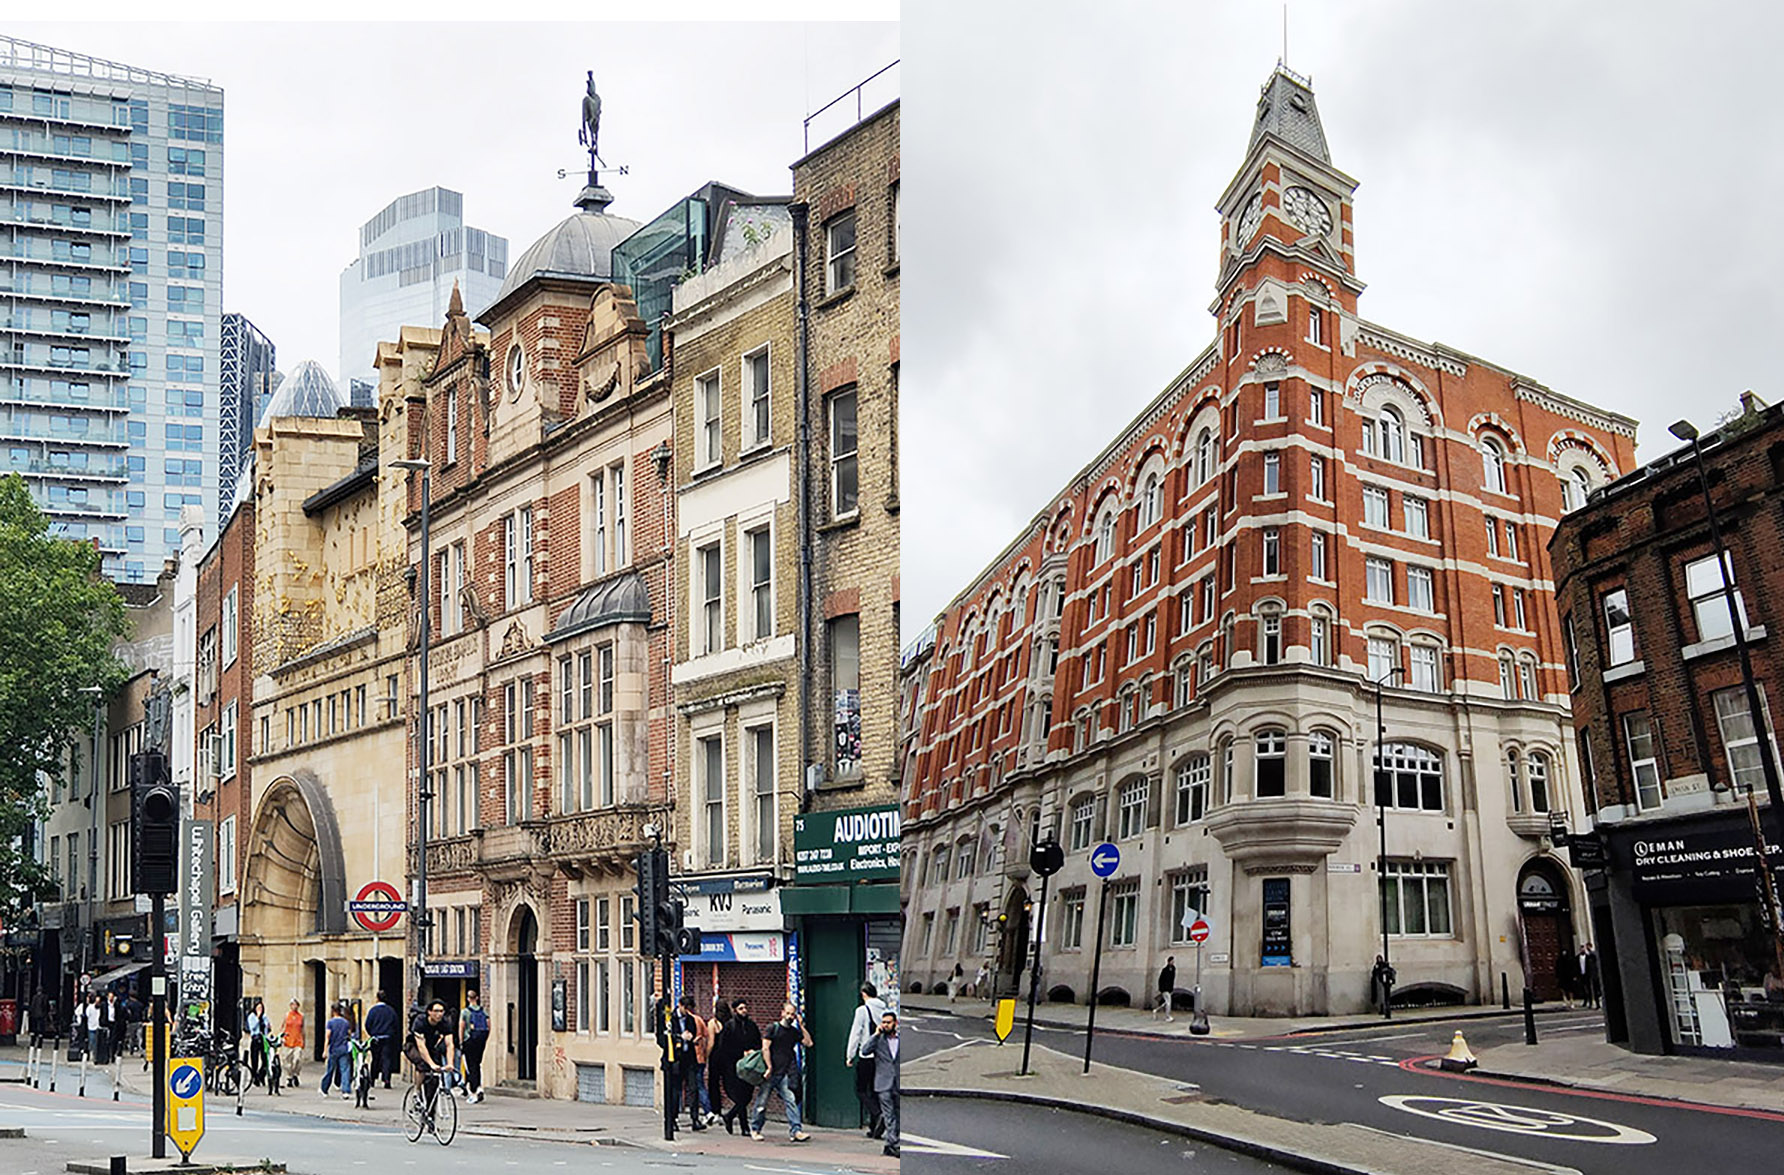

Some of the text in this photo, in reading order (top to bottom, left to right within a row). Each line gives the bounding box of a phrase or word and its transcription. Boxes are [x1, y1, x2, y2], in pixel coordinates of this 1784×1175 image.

[619, 165, 629, 176] N
[796, 819, 804, 831] 75
[1635, 855, 1656, 867] DRY
[1657, 850, 1712, 865] CLEANING
[1712, 849, 1722, 860] &
[1723, 846, 1755, 859] SHOE
[189, 826, 203, 907] Whitechapel
[351, 902, 406, 911] UNDERGROUND
[741, 902, 772, 915] Panasonic
